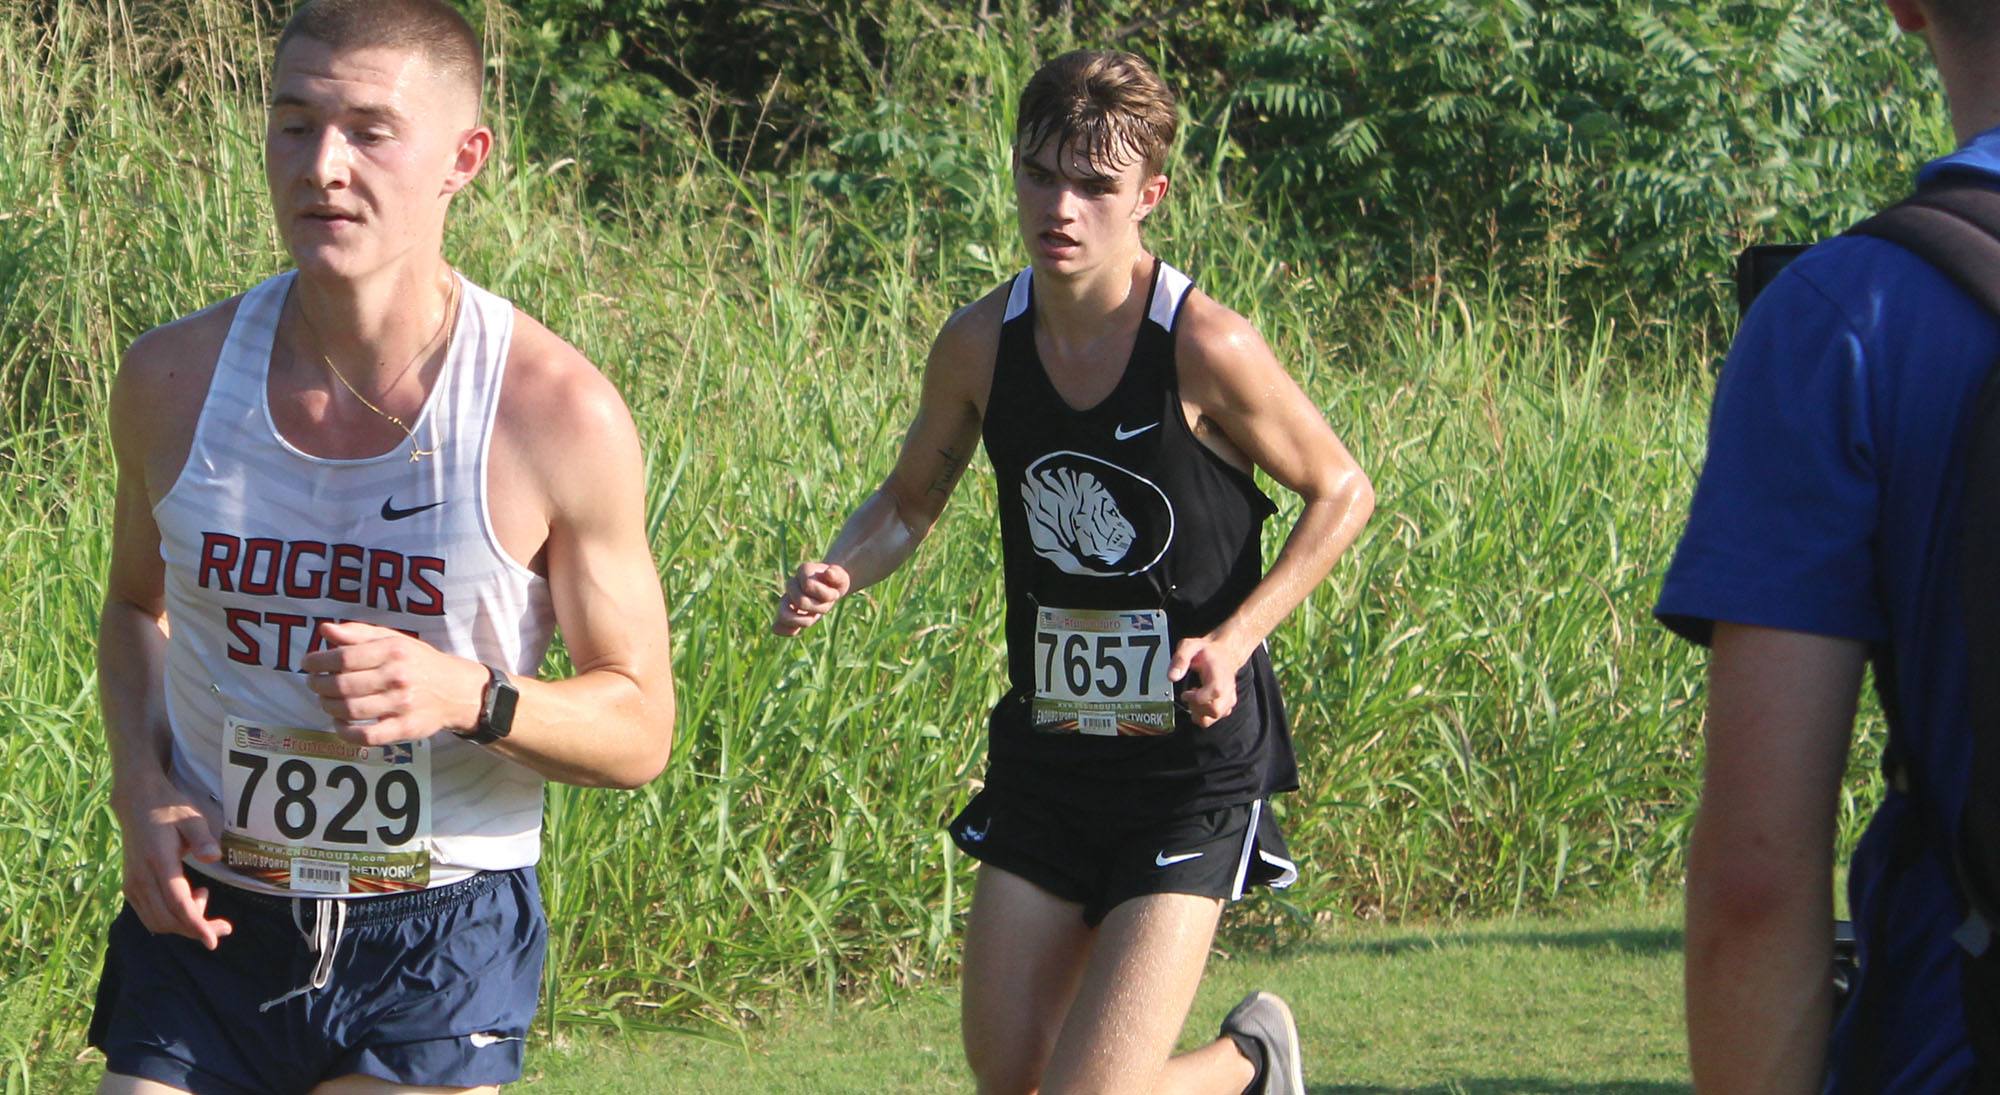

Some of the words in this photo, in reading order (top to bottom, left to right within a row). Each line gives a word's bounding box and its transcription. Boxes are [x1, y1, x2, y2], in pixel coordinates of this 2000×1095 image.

[198, 531, 446, 616] ROGERS
[223, 607, 419, 675] STA
[1037, 632, 1161, 697] 7657
[1117, 712, 1163, 726] NETWORK
[229, 750, 420, 846] 7829
[228, 847, 257, 868] ENDURO
[351, 863, 415, 878] NETWORK
